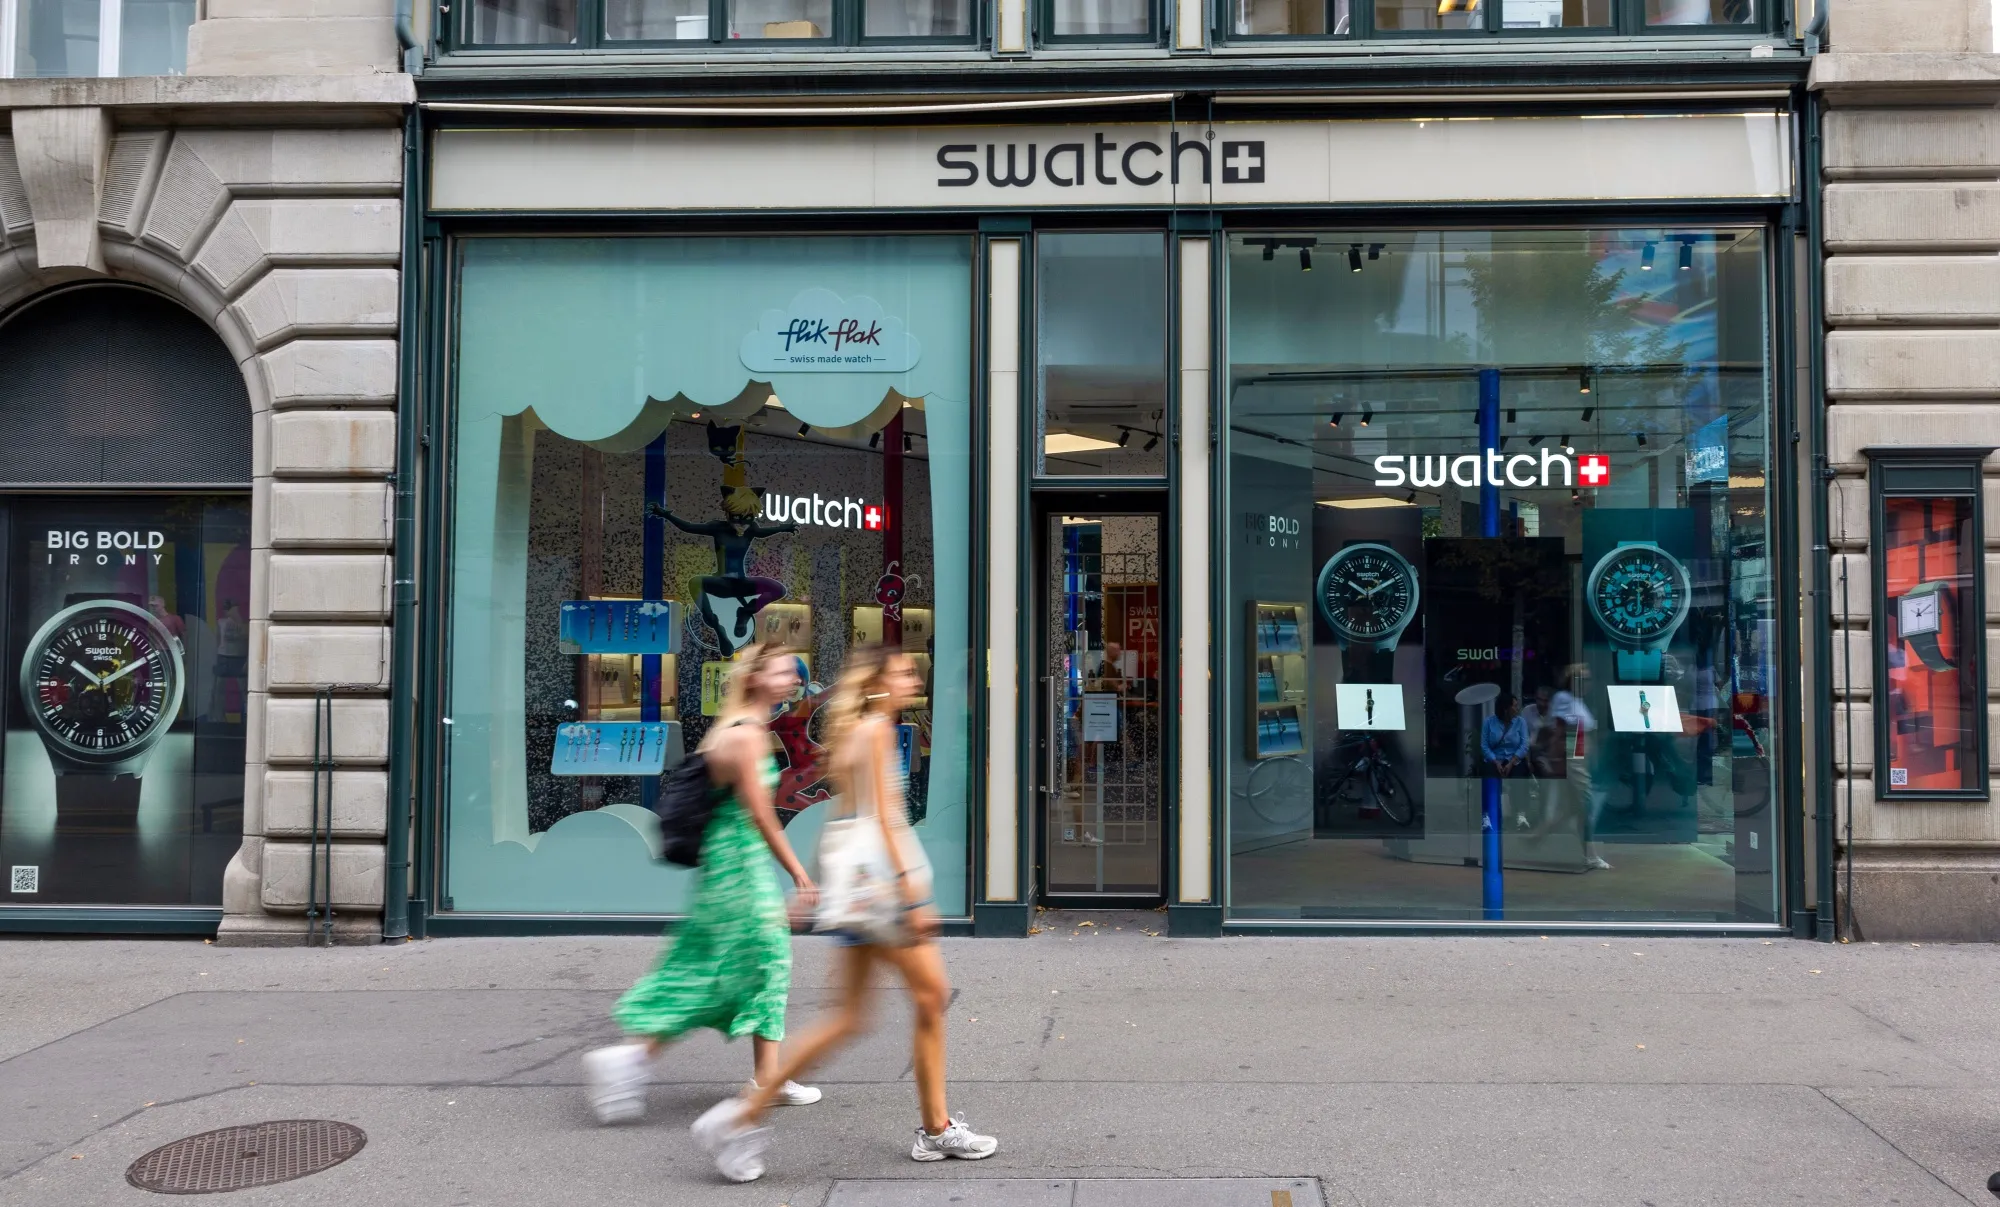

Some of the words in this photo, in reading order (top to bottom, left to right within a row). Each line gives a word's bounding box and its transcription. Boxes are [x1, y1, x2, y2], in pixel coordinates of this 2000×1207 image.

[777, 318, 829, 352] flik
[828, 318, 882, 352] flak
[790, 355, 815, 363] swiss
[817, 355, 843, 363] made
[845, 355, 872, 363] watch
[1374, 447, 1574, 487] swatch
[755, 493, 864, 529] watch
[1269, 515, 1299, 535] BOLD
[47, 530, 89, 549] BIG
[96, 531, 165, 549] BOLD
[48, 553, 163, 566] IRONY
[1129, 618, 1158, 637] PA
[85, 647, 122, 656] swatch
